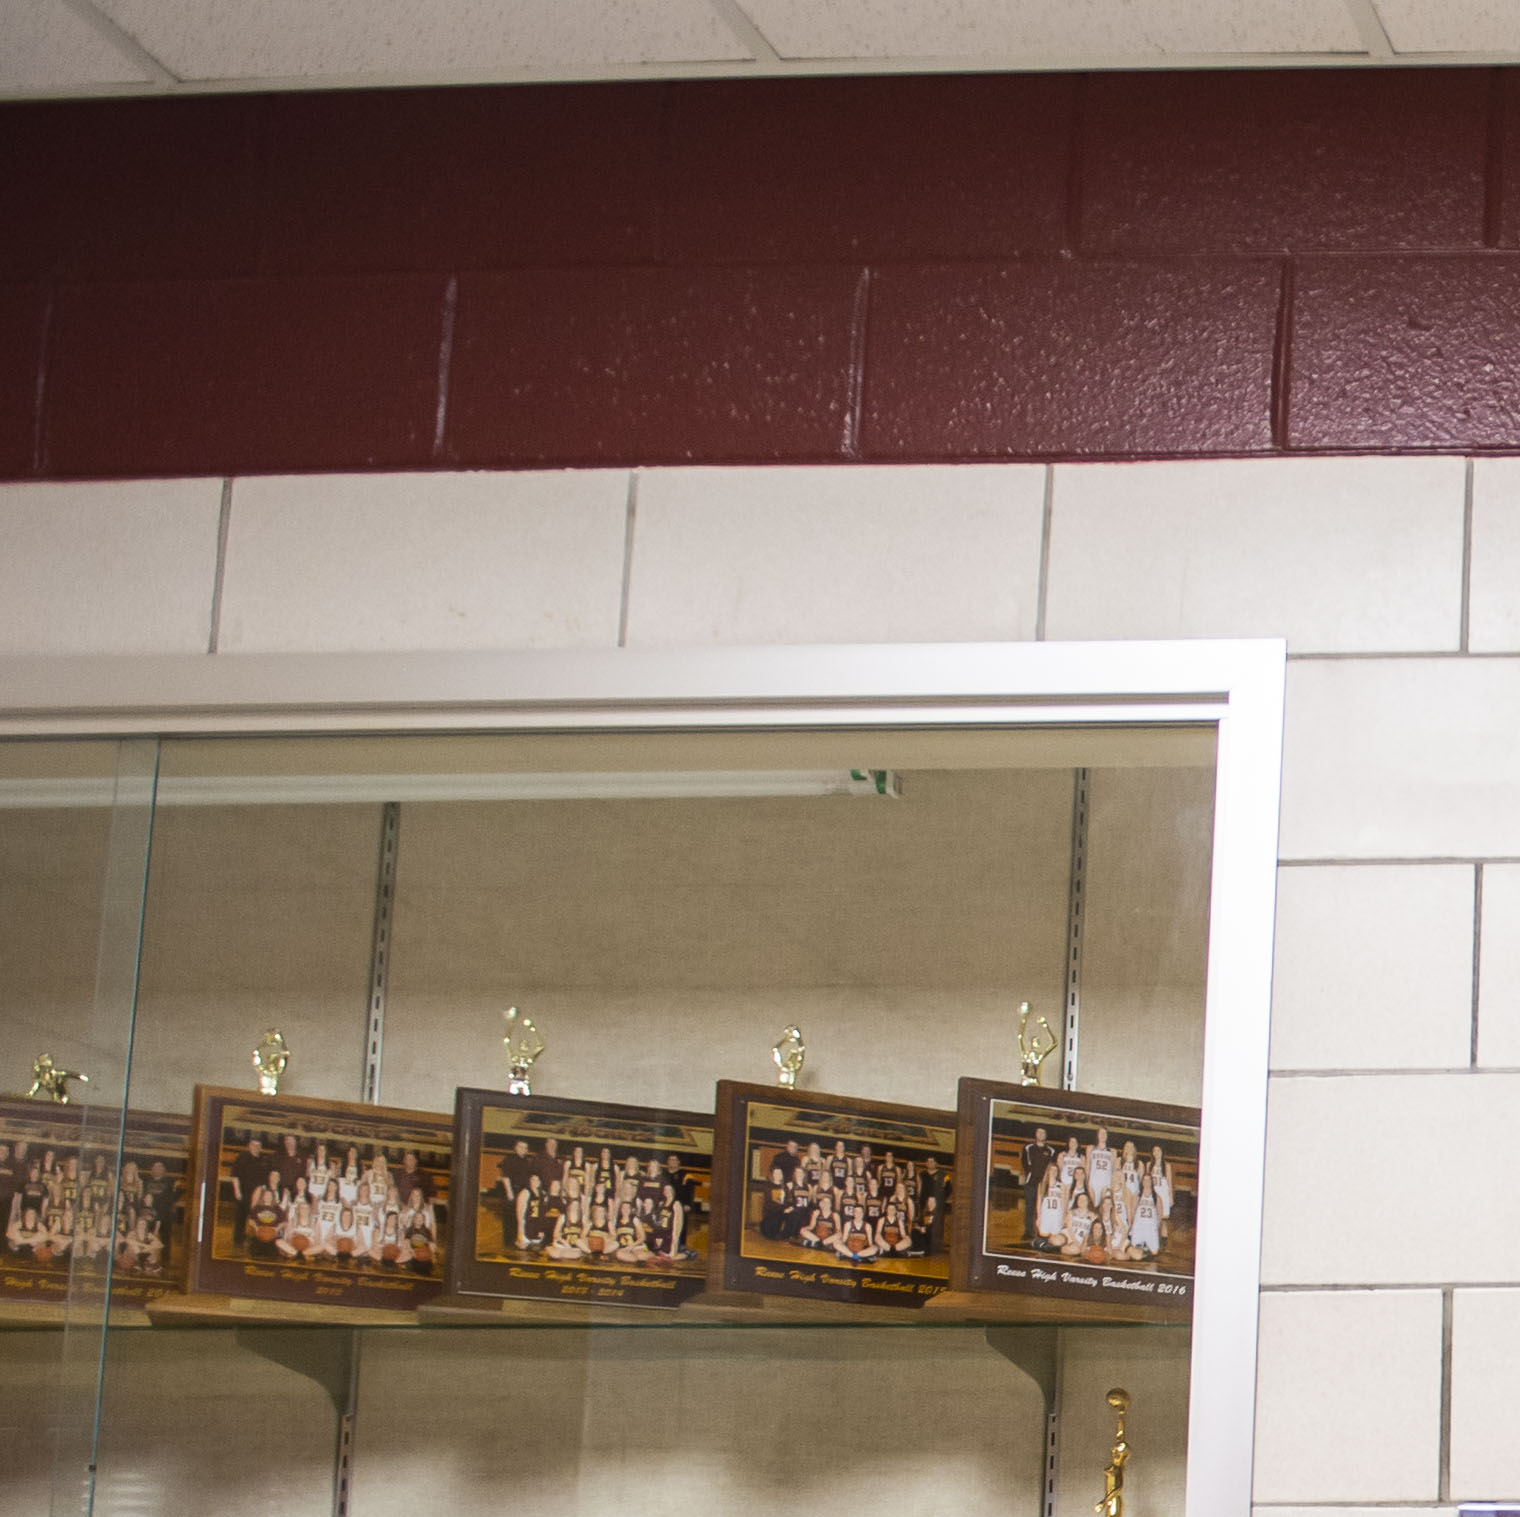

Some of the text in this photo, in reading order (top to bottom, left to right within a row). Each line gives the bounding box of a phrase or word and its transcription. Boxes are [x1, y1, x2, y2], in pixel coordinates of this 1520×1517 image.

[789, 1270, 816, 1284] High
[820, 1273, 858, 1288] Varsity
[861, 1277, 914, 1293] Basketball
[997, 1264, 1187, 1295] Reese High Varsity Basketball 2016
